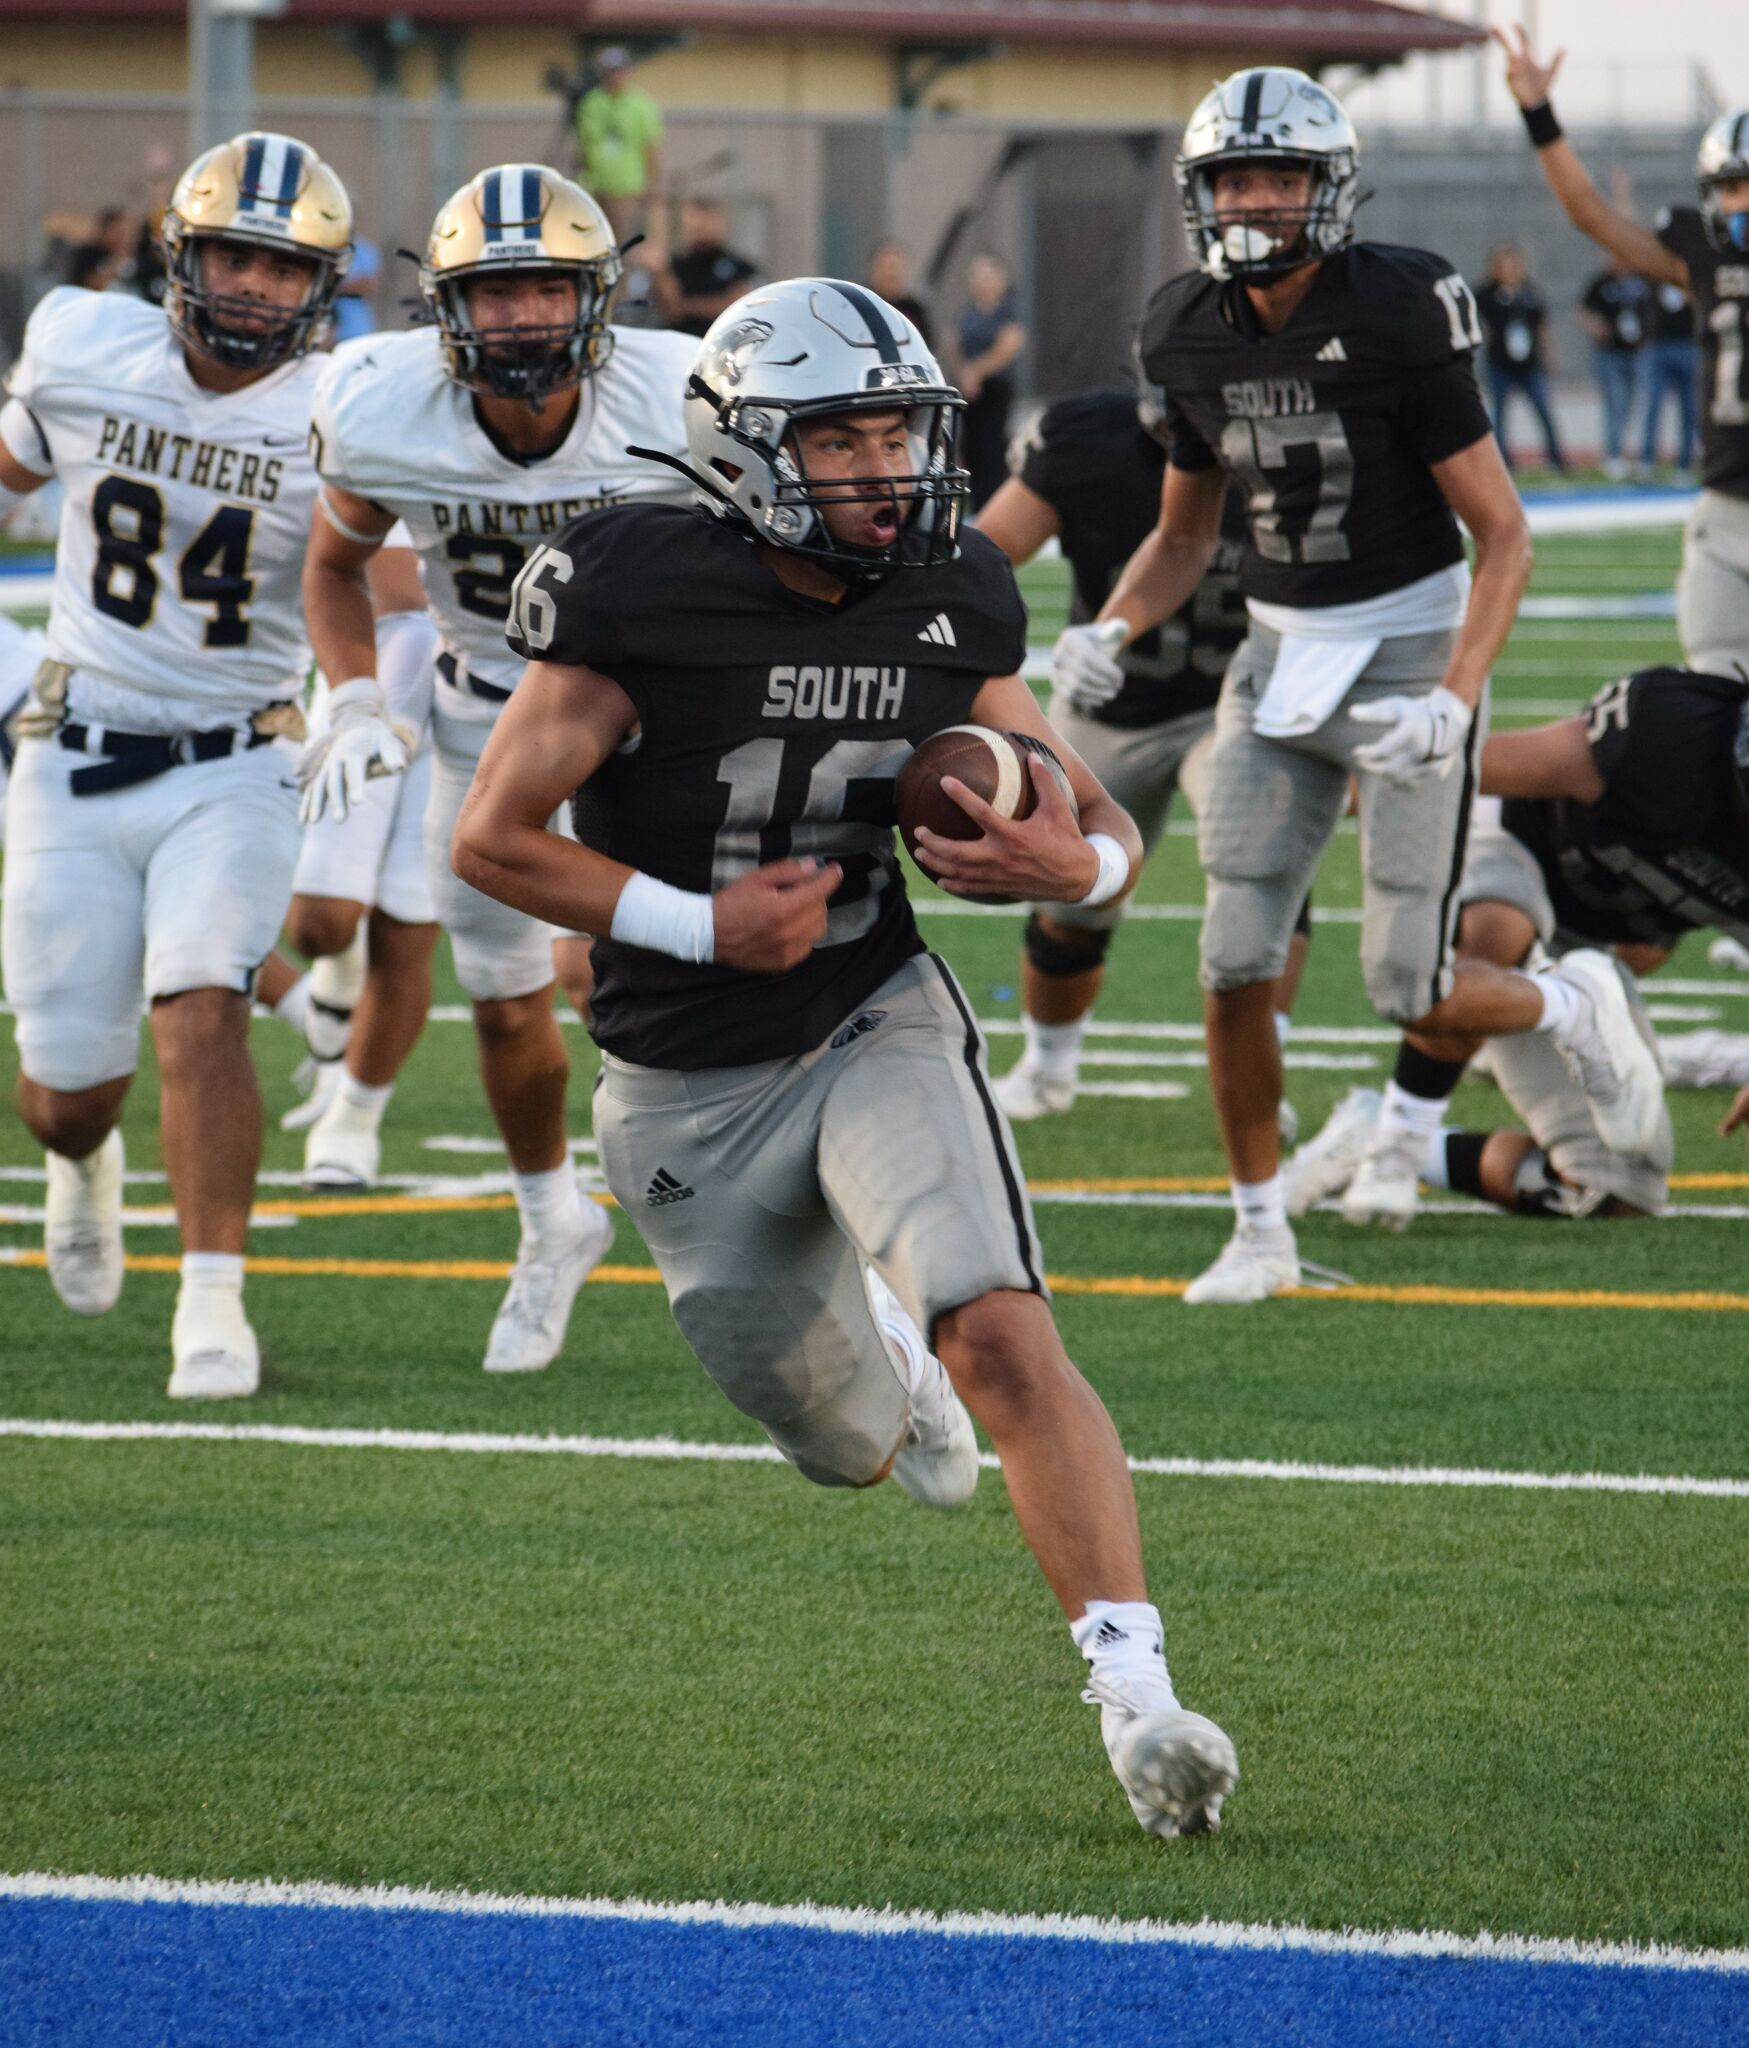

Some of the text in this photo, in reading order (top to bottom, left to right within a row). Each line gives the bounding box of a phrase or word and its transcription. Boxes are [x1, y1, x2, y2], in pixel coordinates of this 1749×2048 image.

[1433, 273, 1483, 351] 17
[1221, 377, 1316, 419] SOUTH
[1707, 302, 1749, 425] 1
[96, 416, 284, 504] PANTHERS
[1220, 411, 1355, 564] 17
[91, 469, 264, 648] 84
[432, 496, 628, 537] PANTHE
[505, 543, 575, 651] 16
[761, 665, 907, 721] SOUTH
[710, 736, 916, 950] 16
[646, 1187, 696, 1207] adidas
